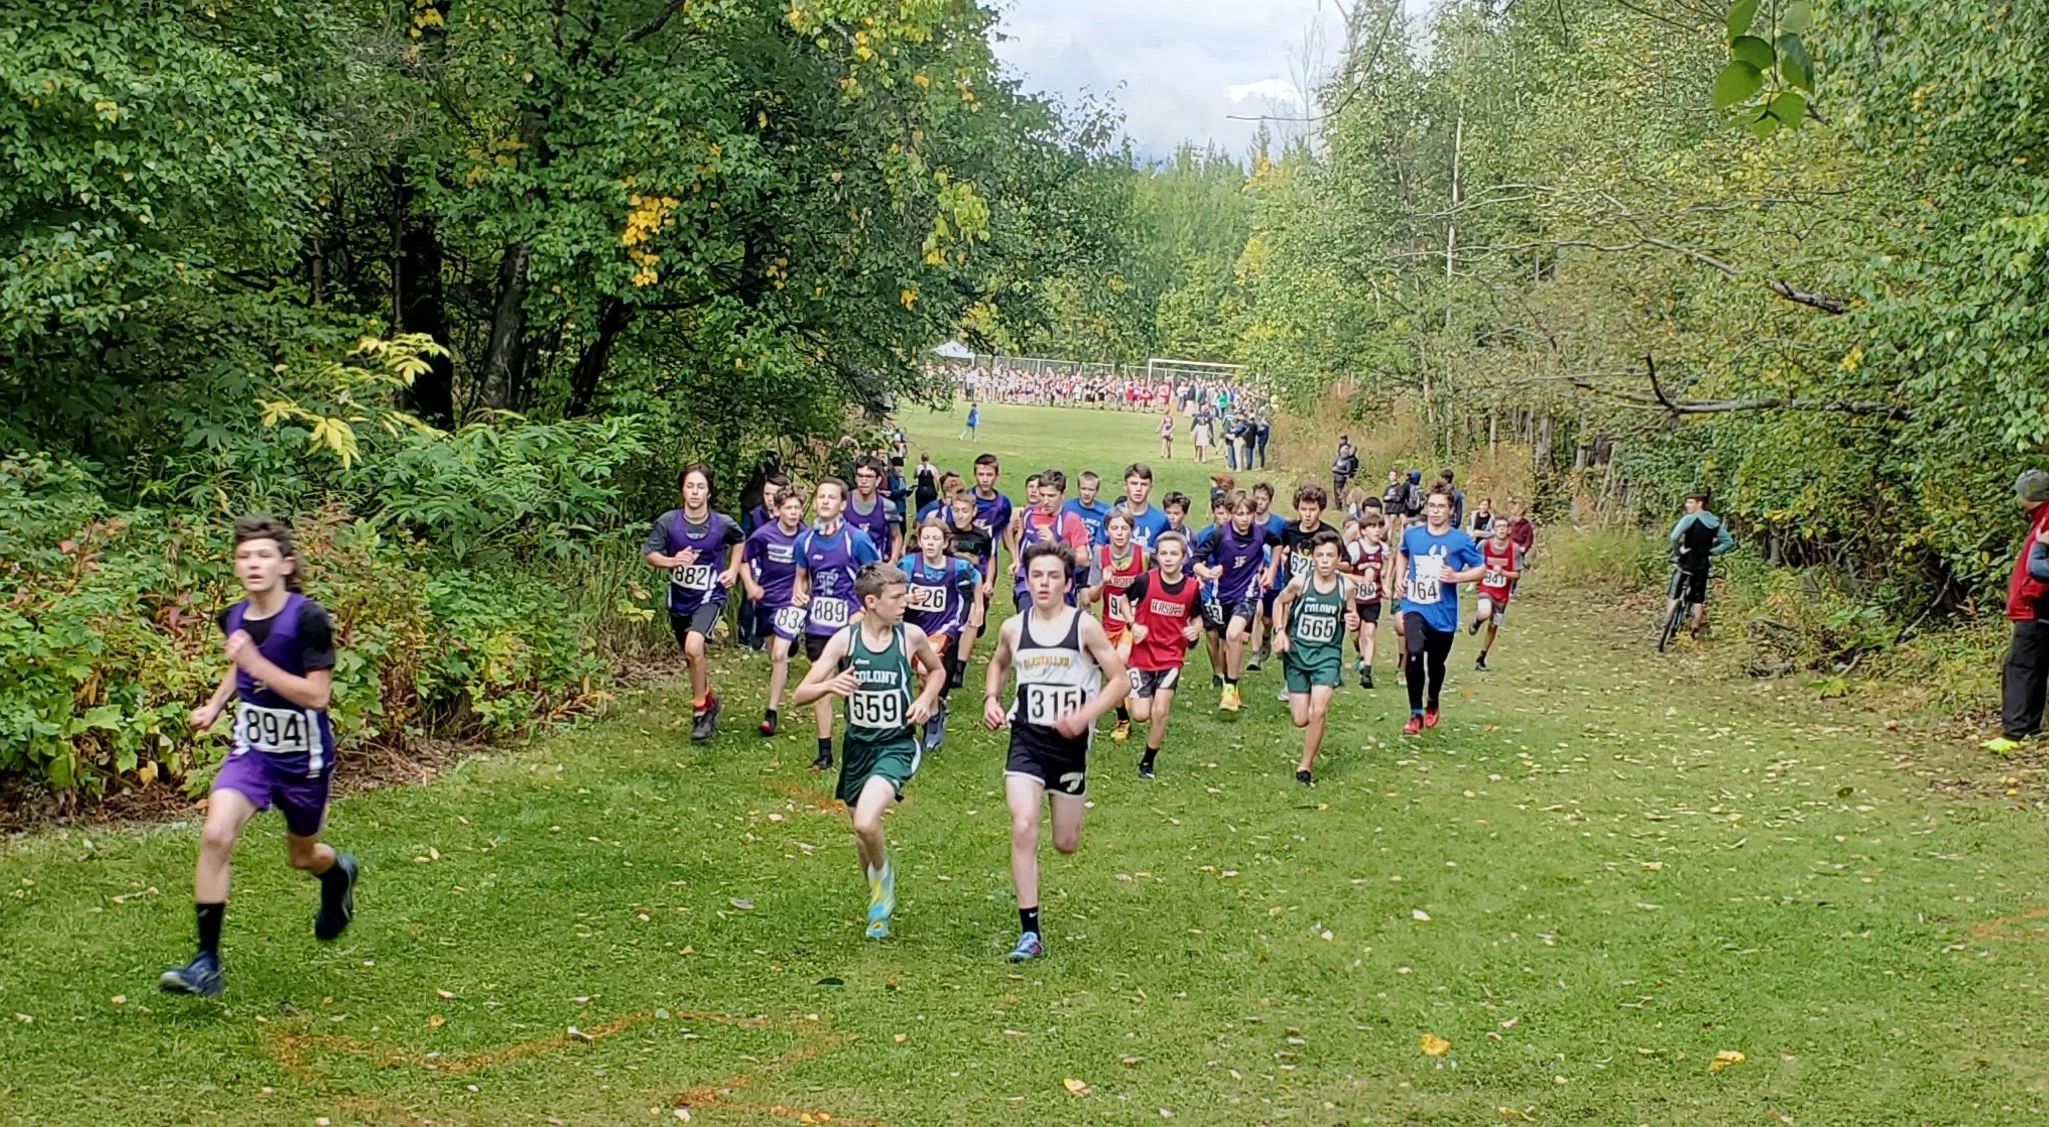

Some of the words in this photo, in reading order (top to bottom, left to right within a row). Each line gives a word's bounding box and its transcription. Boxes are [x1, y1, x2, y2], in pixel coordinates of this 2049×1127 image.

[675, 565, 707, 586] 882
[814, 600, 845, 622] 889
[1301, 617, 1334, 639] 565
[853, 669, 898, 685] COLONY
[853, 692, 898, 723] 559
[1031, 689, 1077, 721] 315
[246, 708, 302, 747] 894
